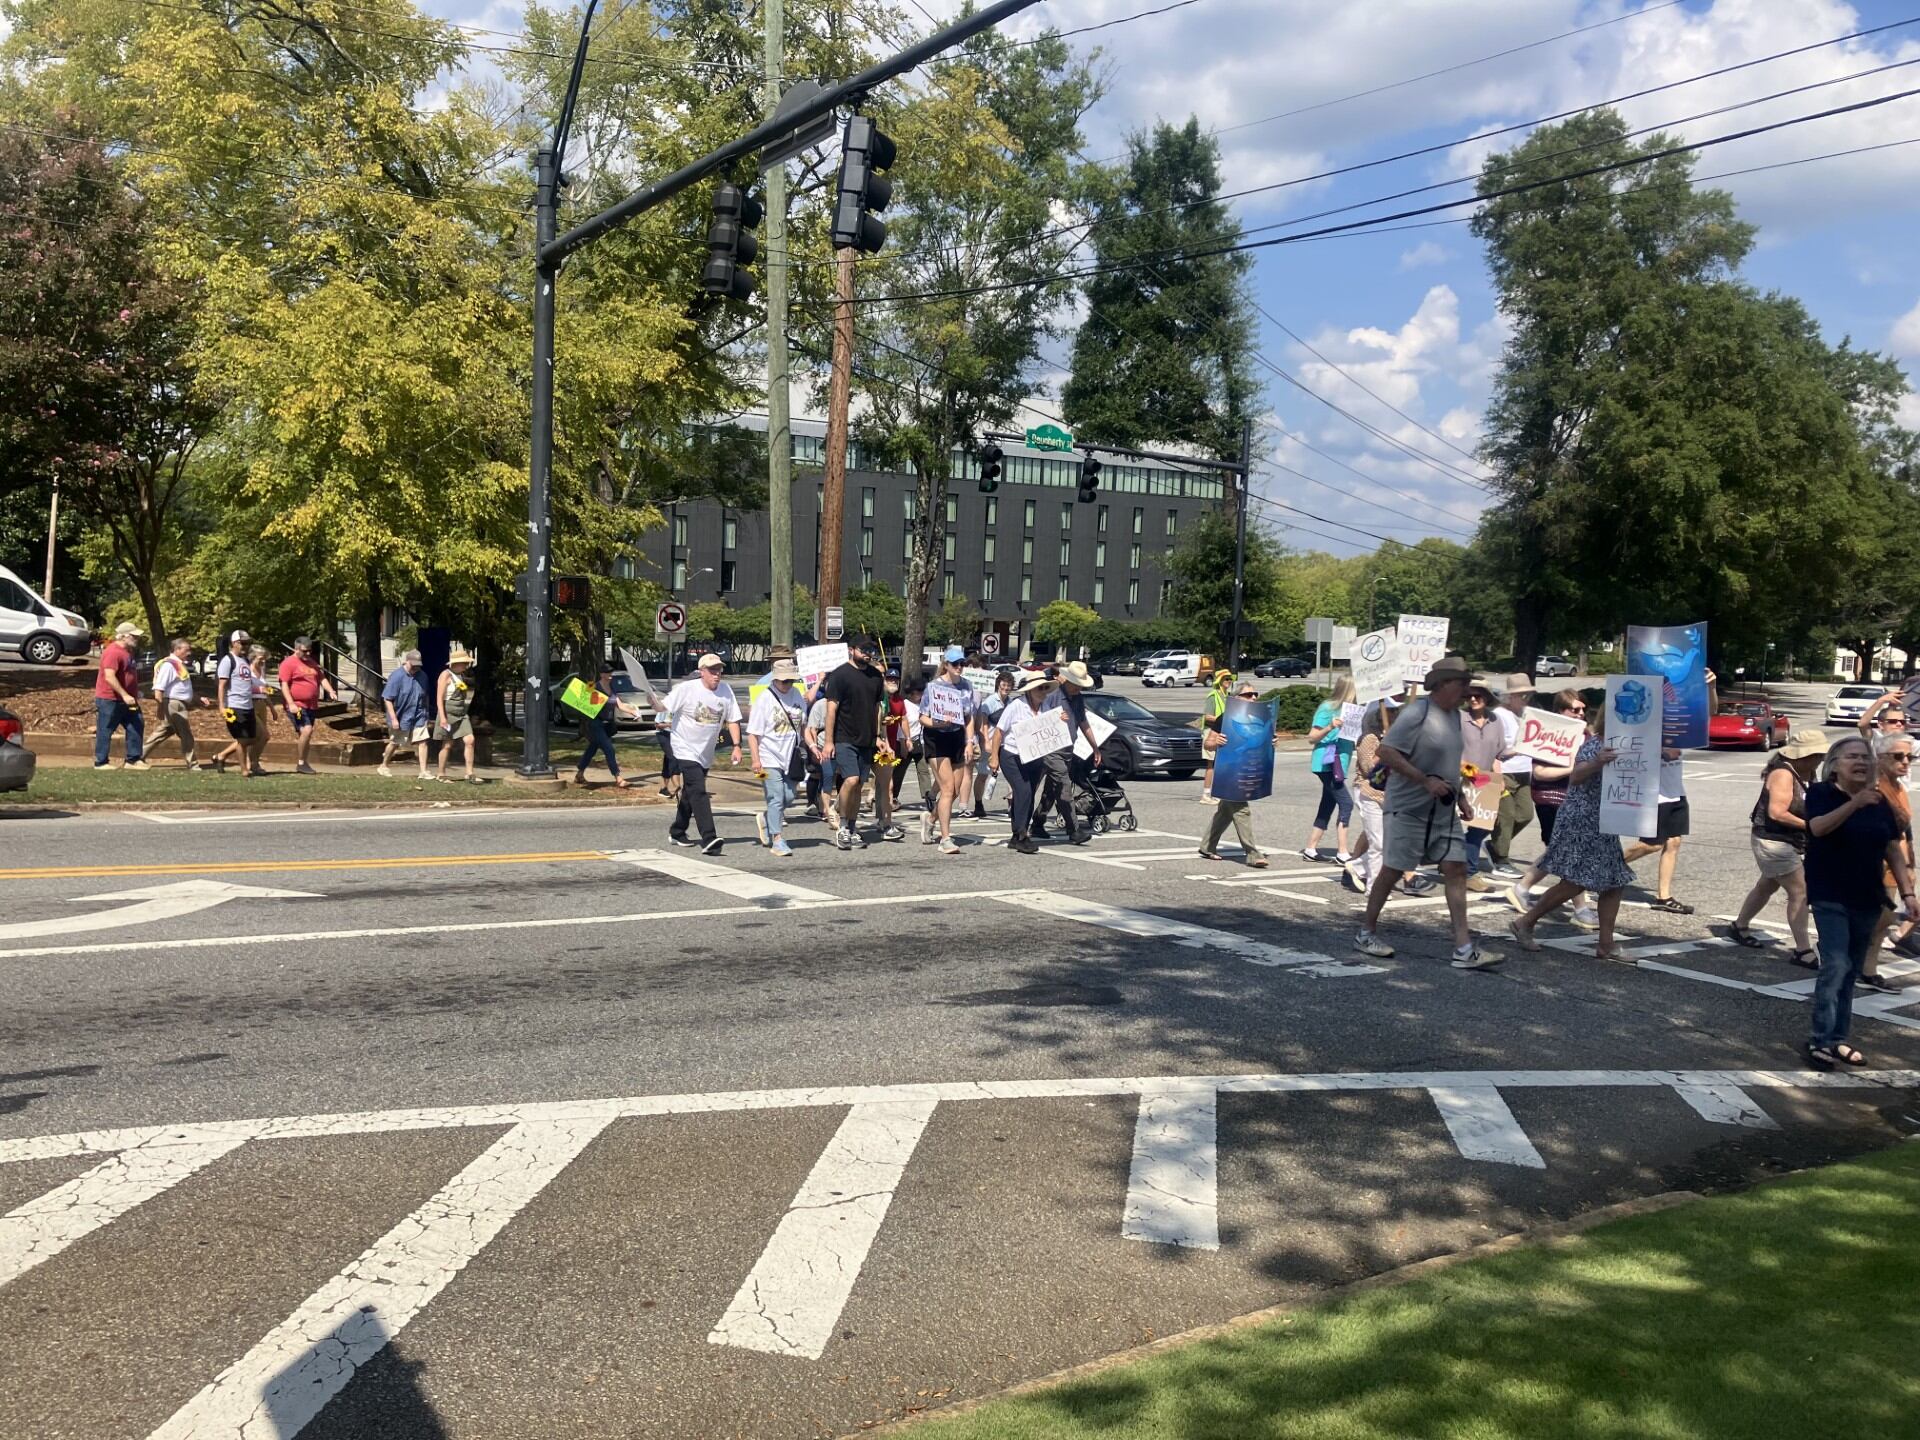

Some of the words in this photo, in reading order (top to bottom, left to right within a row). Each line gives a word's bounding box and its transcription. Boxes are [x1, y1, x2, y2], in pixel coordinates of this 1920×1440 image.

[1402, 619, 1445, 633] TROOPS
[1403, 633, 1426, 645] OUT
[1428, 636, 1445, 648] OF
[1409, 648, 1431, 662] US
[1031, 724, 1060, 744] JESUS
[1522, 719, 1576, 748] Dignidad
[1608, 736, 1644, 750] ICE
